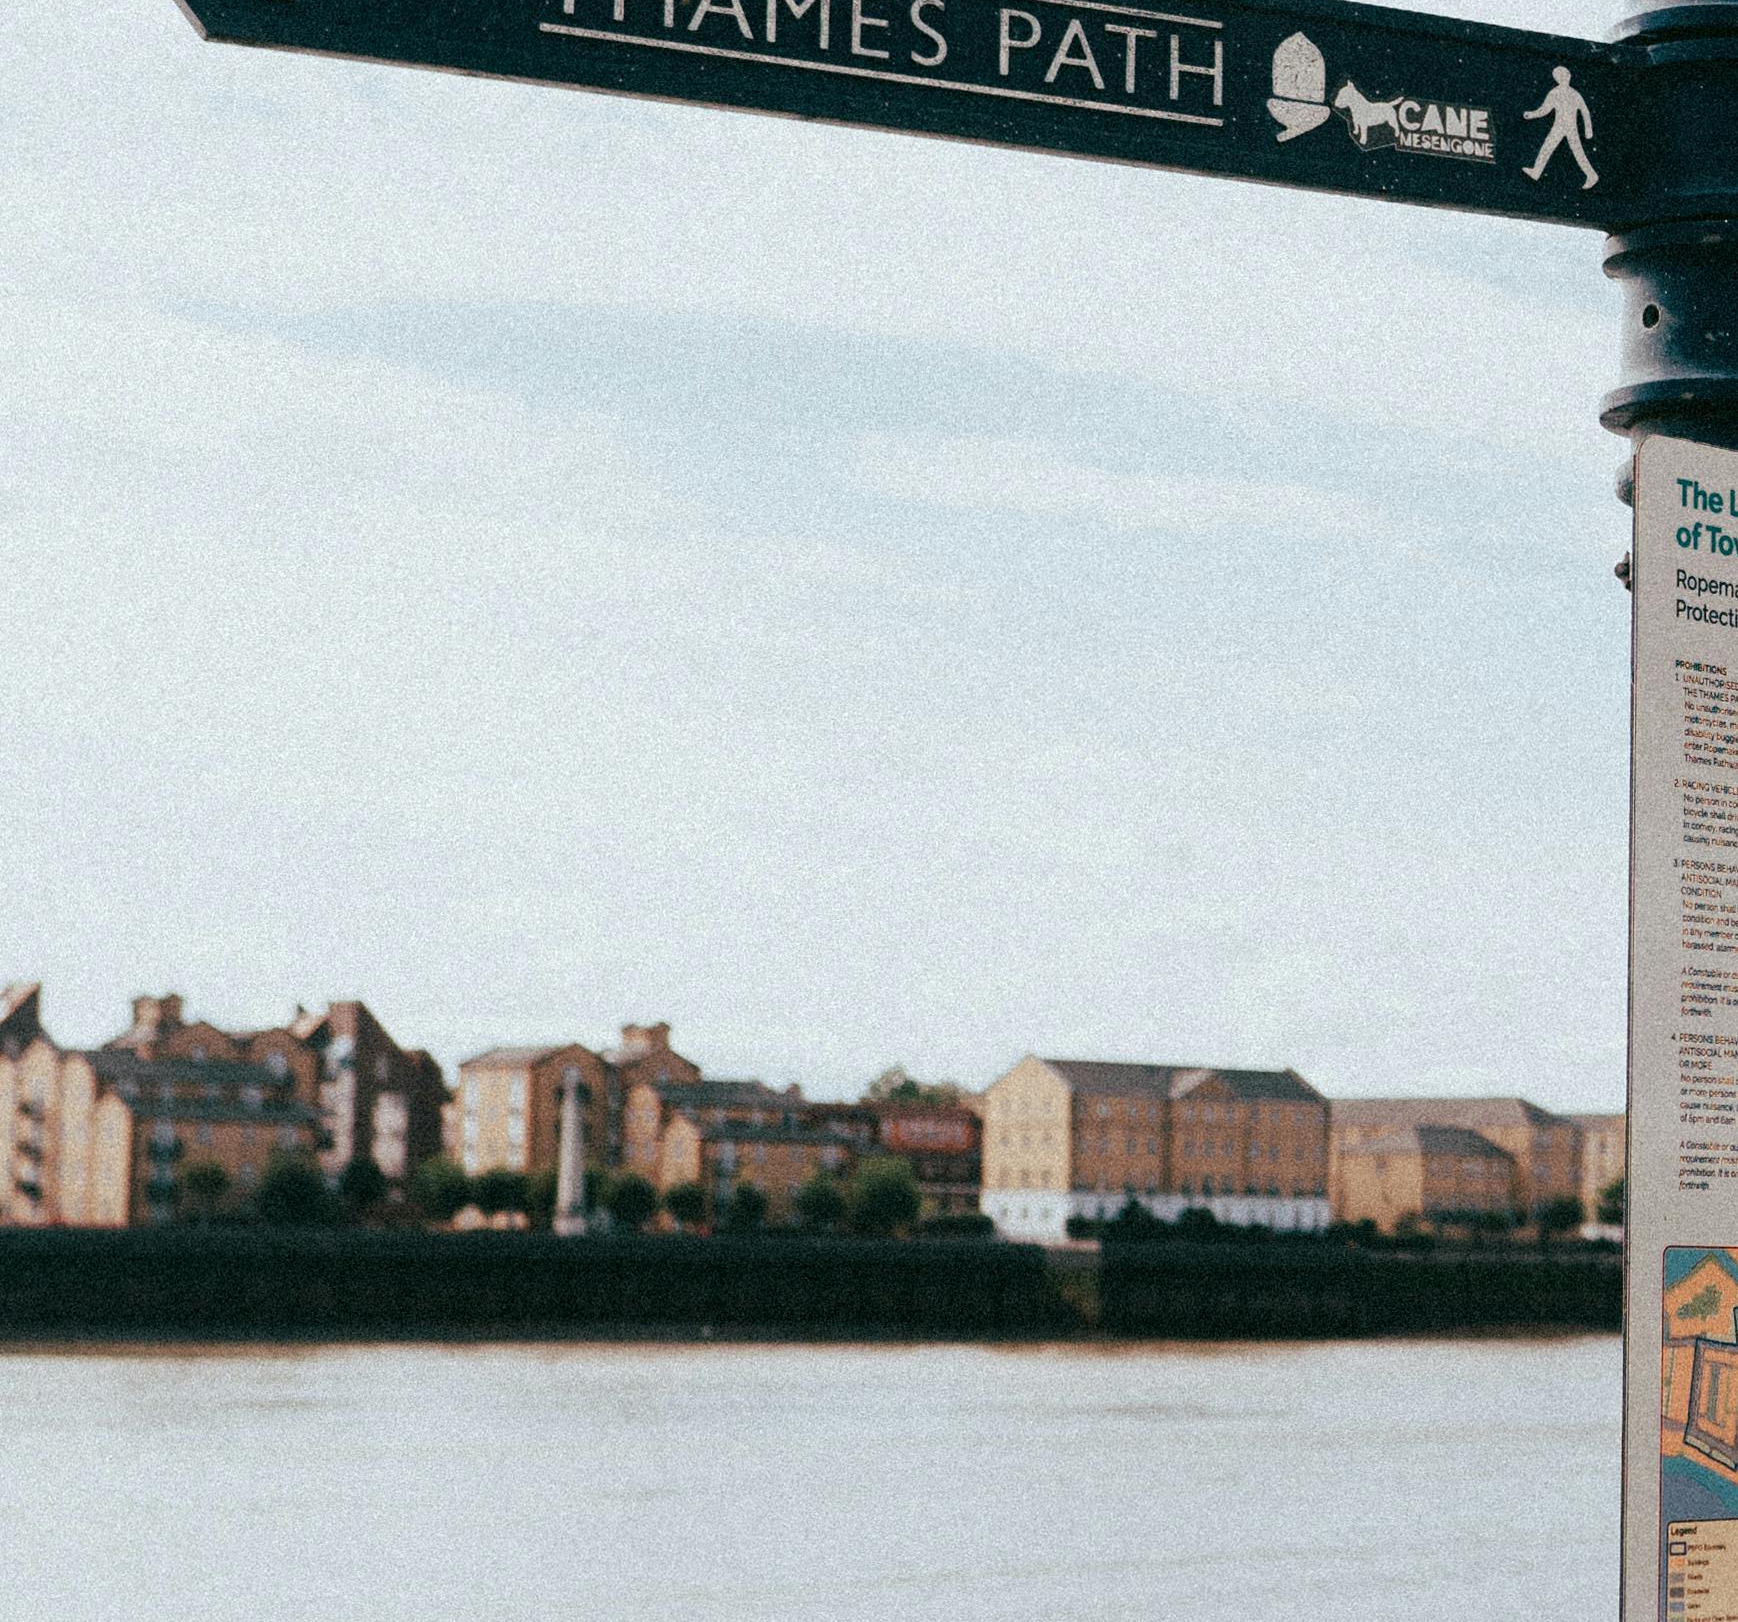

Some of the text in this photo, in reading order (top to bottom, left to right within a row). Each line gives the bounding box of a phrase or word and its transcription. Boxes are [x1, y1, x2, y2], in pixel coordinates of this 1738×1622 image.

[999, 8, 1223, 105] PATH
[1399, 100, 1489, 140] CANE
[1400, 132, 1494, 158] MESENGONE
[1676, 478, 1724, 514] The
[1676, 523, 1703, 550] of
